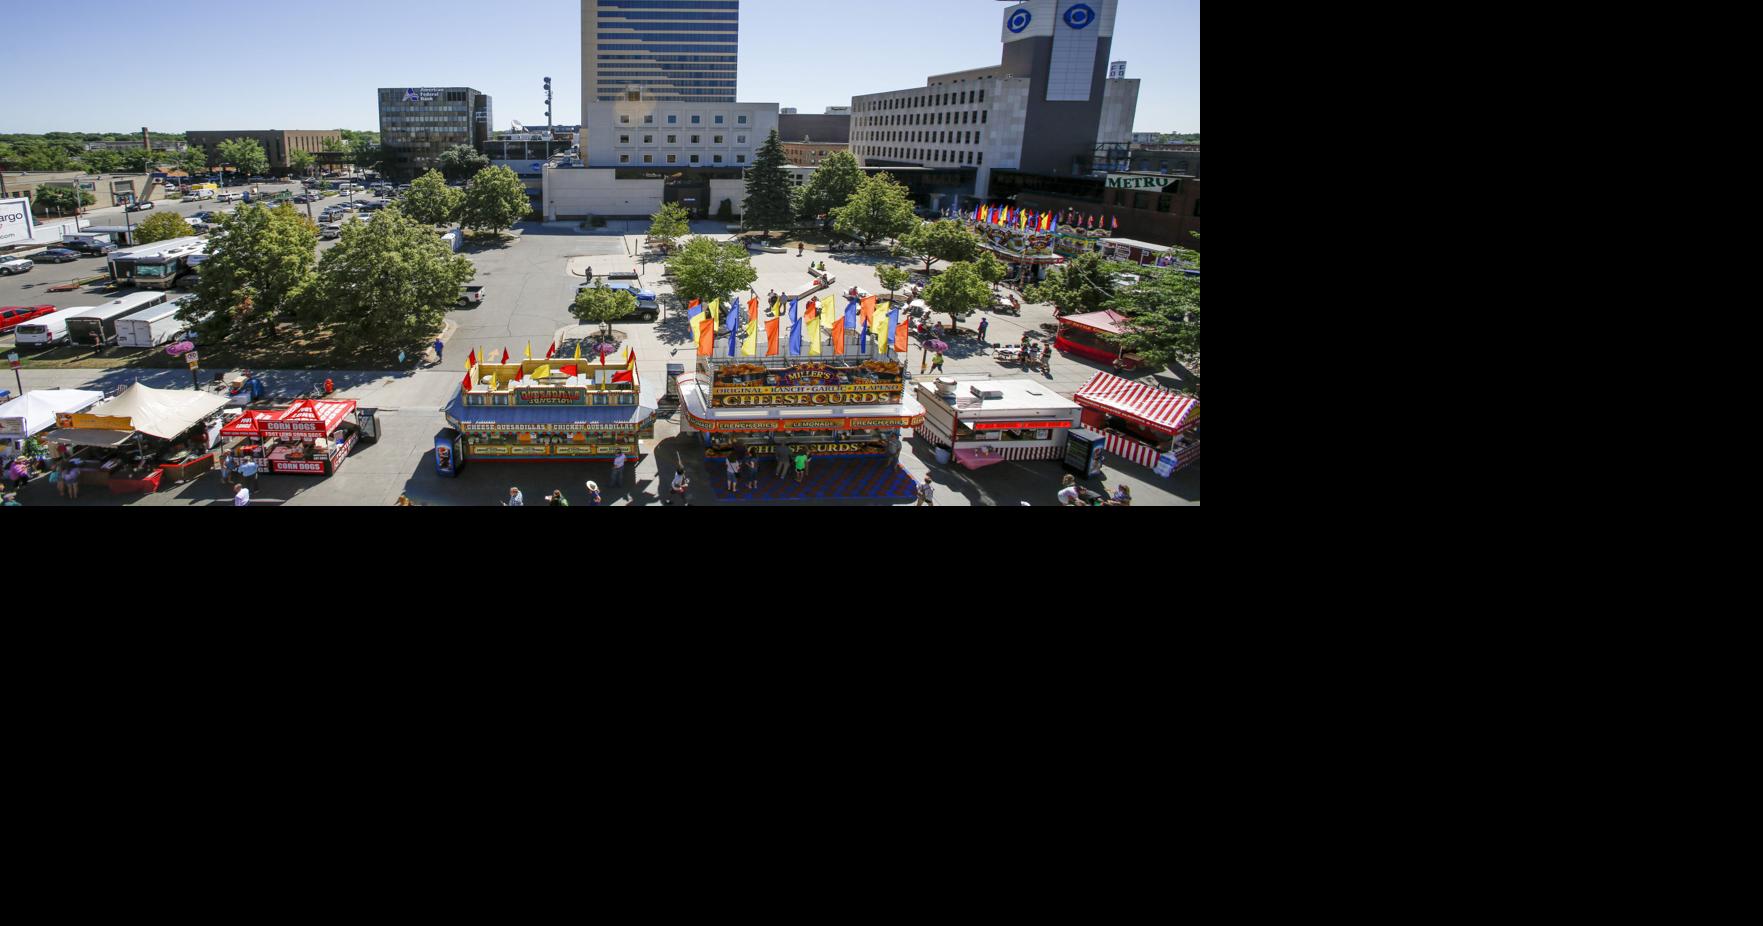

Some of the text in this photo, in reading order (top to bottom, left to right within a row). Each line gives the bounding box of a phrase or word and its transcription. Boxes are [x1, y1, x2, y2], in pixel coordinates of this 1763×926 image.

[788, 370, 831, 380] MILLER'S
[722, 392, 889, 406] CHEESE CURDS
[267, 422, 316, 431] CORN DOGS
[277, 463, 296, 471] CORN
[298, 463, 320, 471] DOGS
